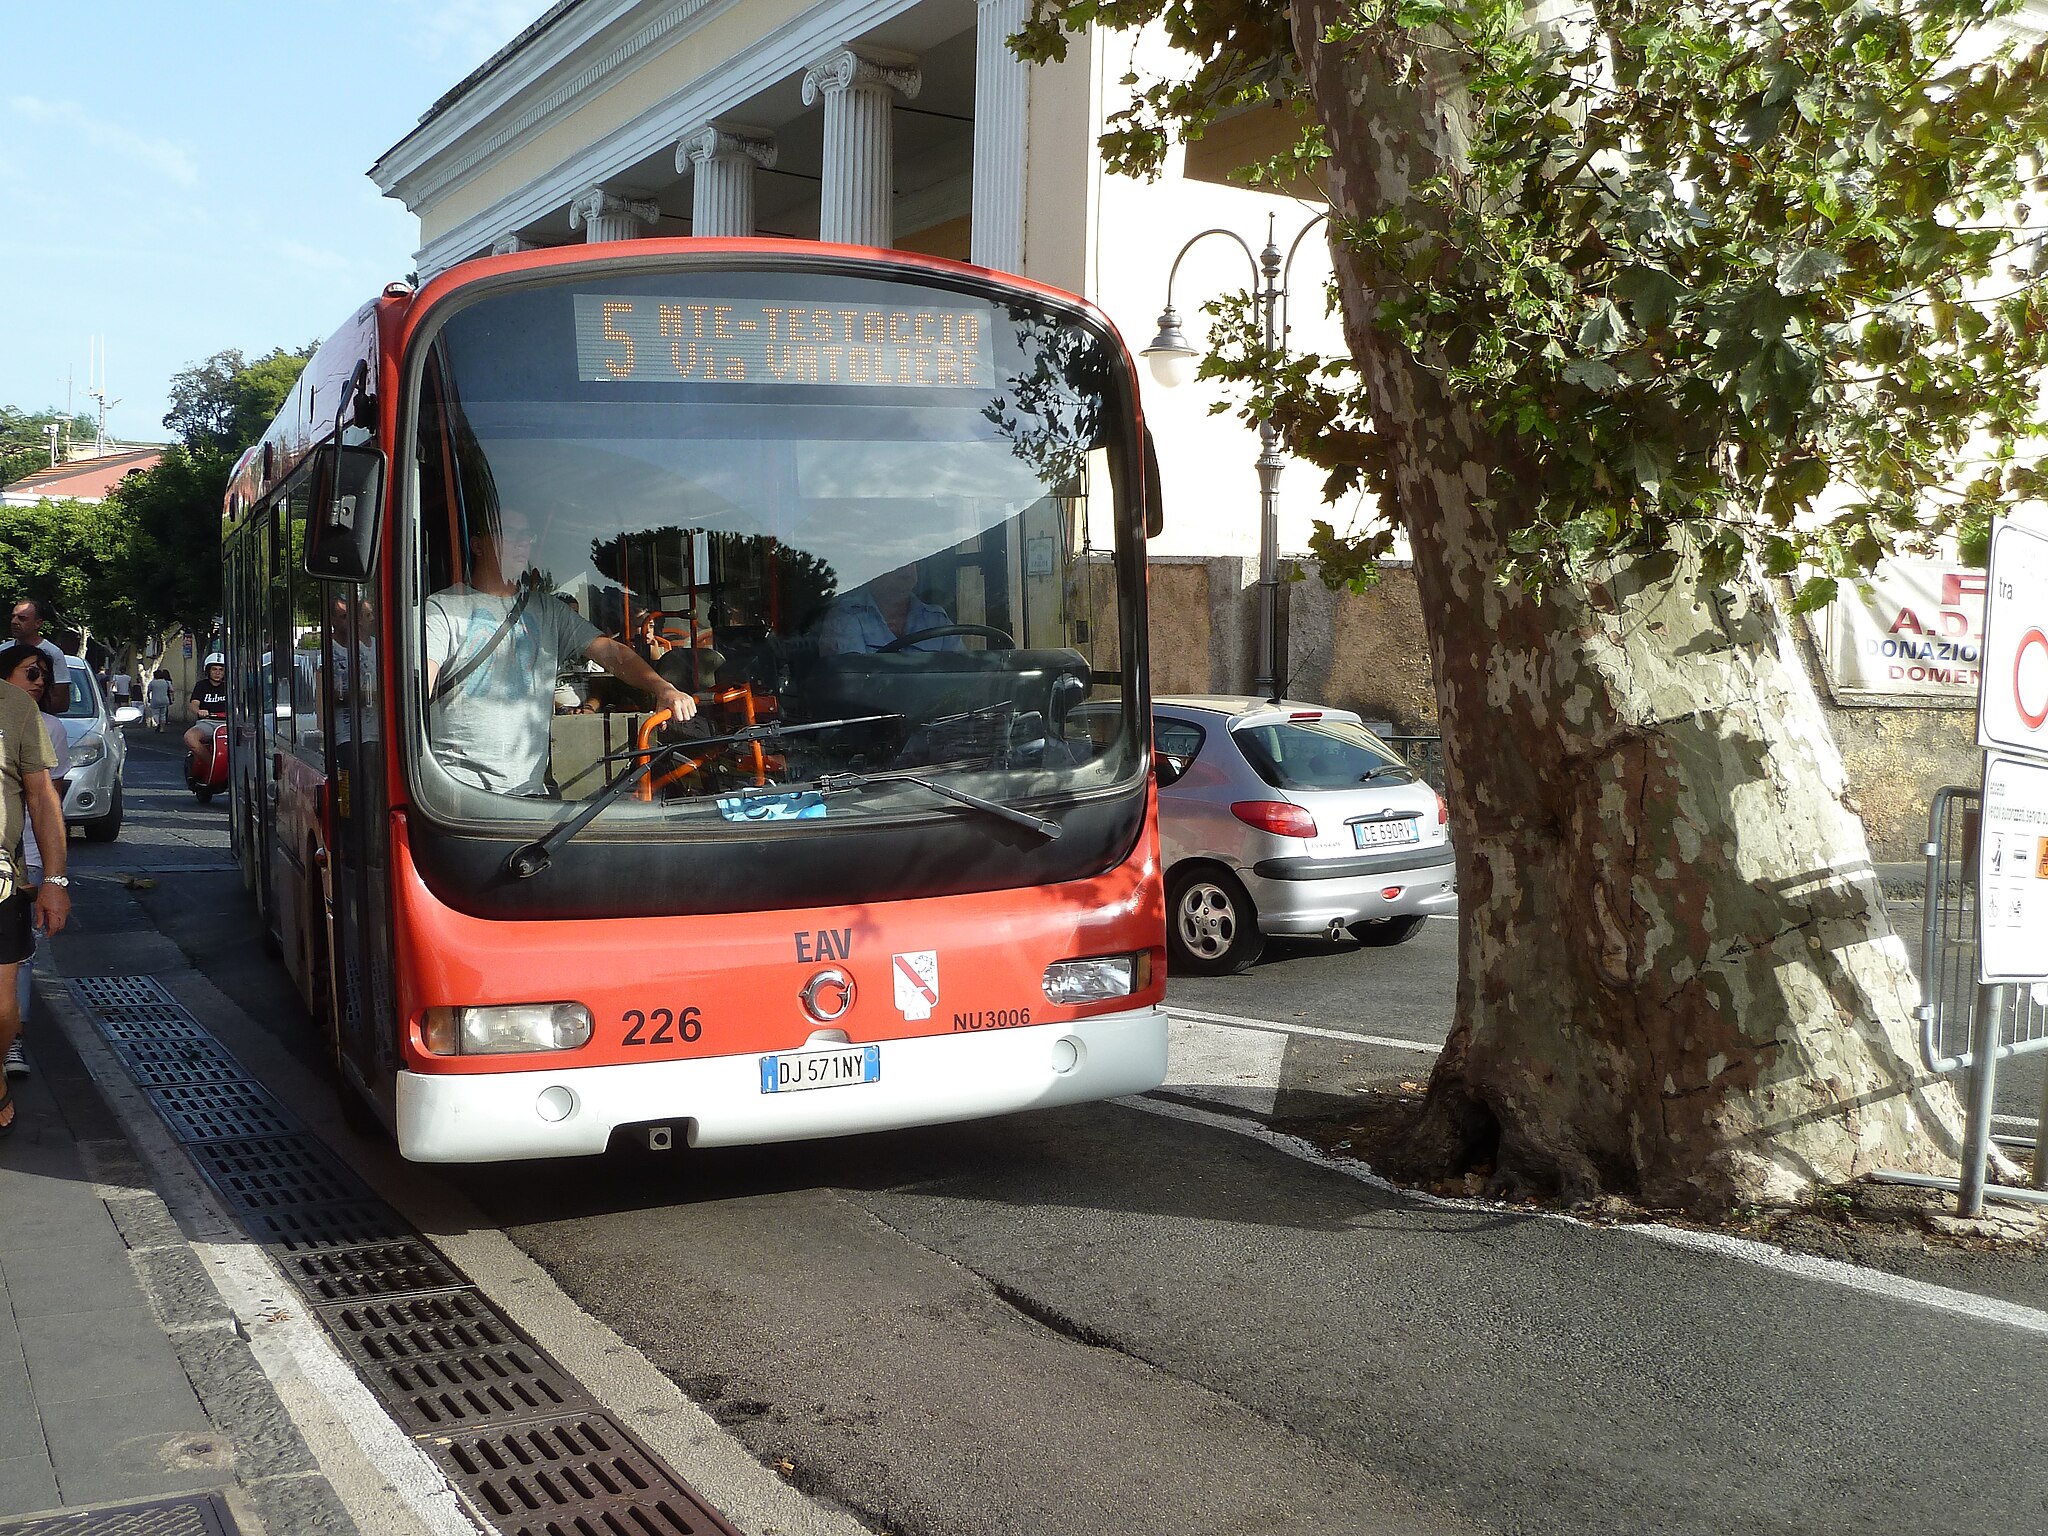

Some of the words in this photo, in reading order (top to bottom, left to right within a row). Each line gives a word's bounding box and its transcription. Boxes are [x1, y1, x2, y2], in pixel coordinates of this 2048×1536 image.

[603, 303, 635, 377] 5
[659, 304, 978, 346] MTE-TESTACCIO
[671, 342, 745, 380] Via
[766, 344, 979, 385] VATOLIERE
[1998, 577, 2013, 599] tra
[1363, 825, 1377, 842] CE
[1379, 822, 1410, 840] 690RV
[794, 928, 851, 963] EAV
[622, 1007, 702, 1046] 226
[953, 1007, 1030, 1031] NU3006
[780, 1060, 801, 1084] DJ
[808, 1055, 862, 1081] 571NY
